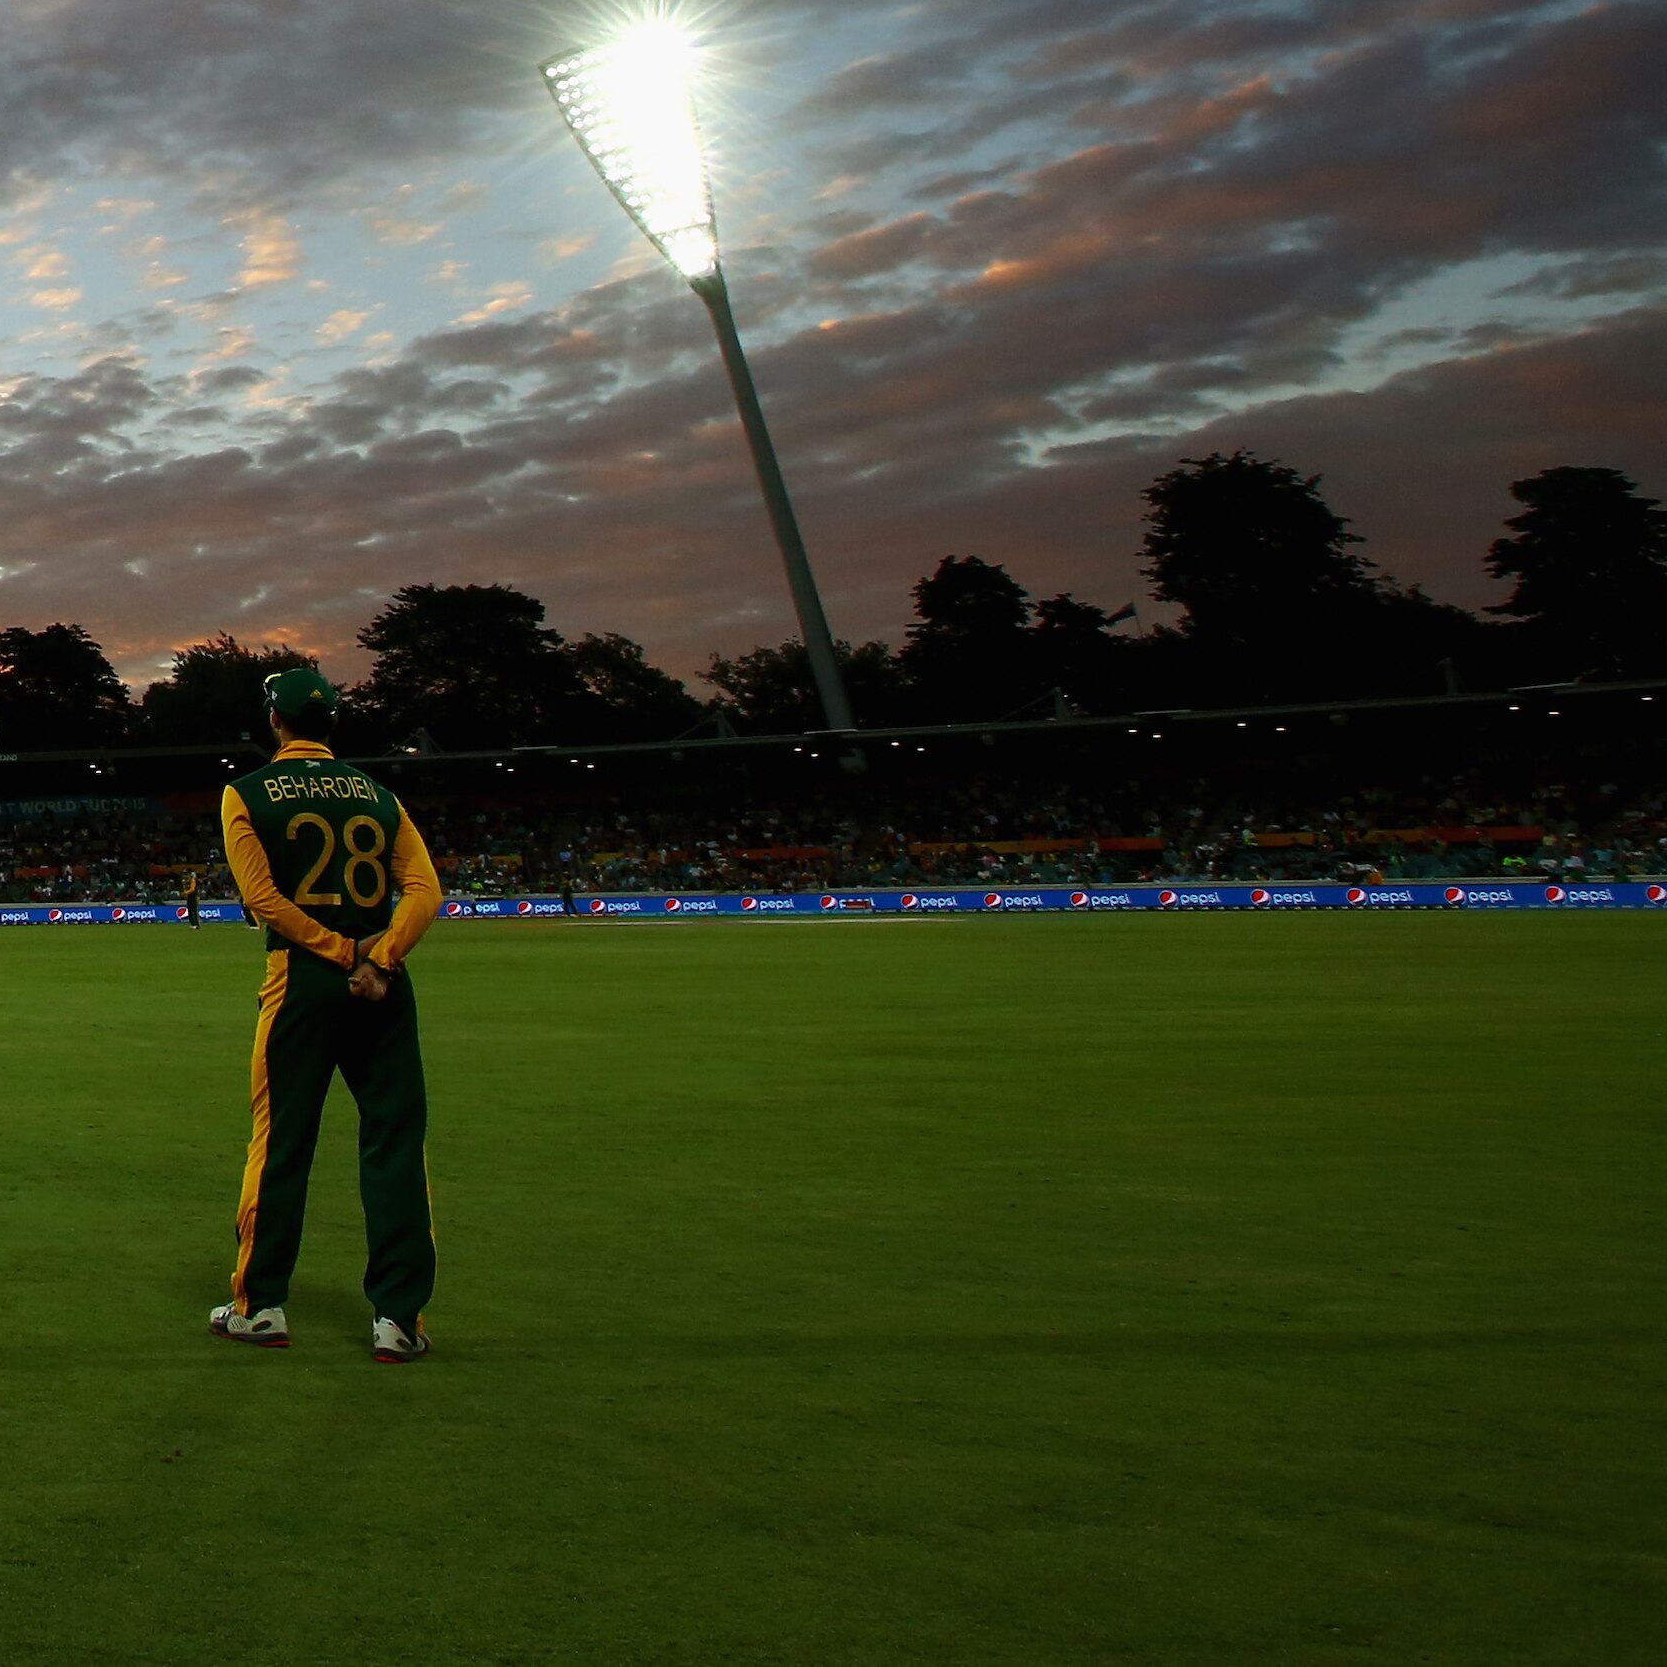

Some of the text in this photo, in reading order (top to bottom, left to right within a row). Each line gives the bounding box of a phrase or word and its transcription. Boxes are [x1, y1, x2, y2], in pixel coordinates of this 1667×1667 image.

[264, 775, 379, 803] BEHARDIEN
[19, 799, 77, 814] WORLD
[285, 812, 387, 908] 28
[921, 896, 958, 908] pepsi
[1004, 894, 1043, 907] pepsi
[1091, 893, 1131, 907] pepsi
[1180, 892, 1221, 906] pepsi
[1272, 891, 1316, 905] pepsi
[1369, 890, 1413, 905] pepsi
[1467, 889, 1514, 904] pepsi
[1568, 888, 1614, 904] pepsi
[534, 902, 564, 913] peps
[608, 901, 641, 912] pepsi
[682, 899, 717, 911] pepsi
[760, 898, 795, 910] pepsi
[1, 912, 29, 922] pepsi
[63, 911, 92, 921] pepsi
[127, 909, 156, 920] pepsi
[198, 908, 221, 919] epsi
